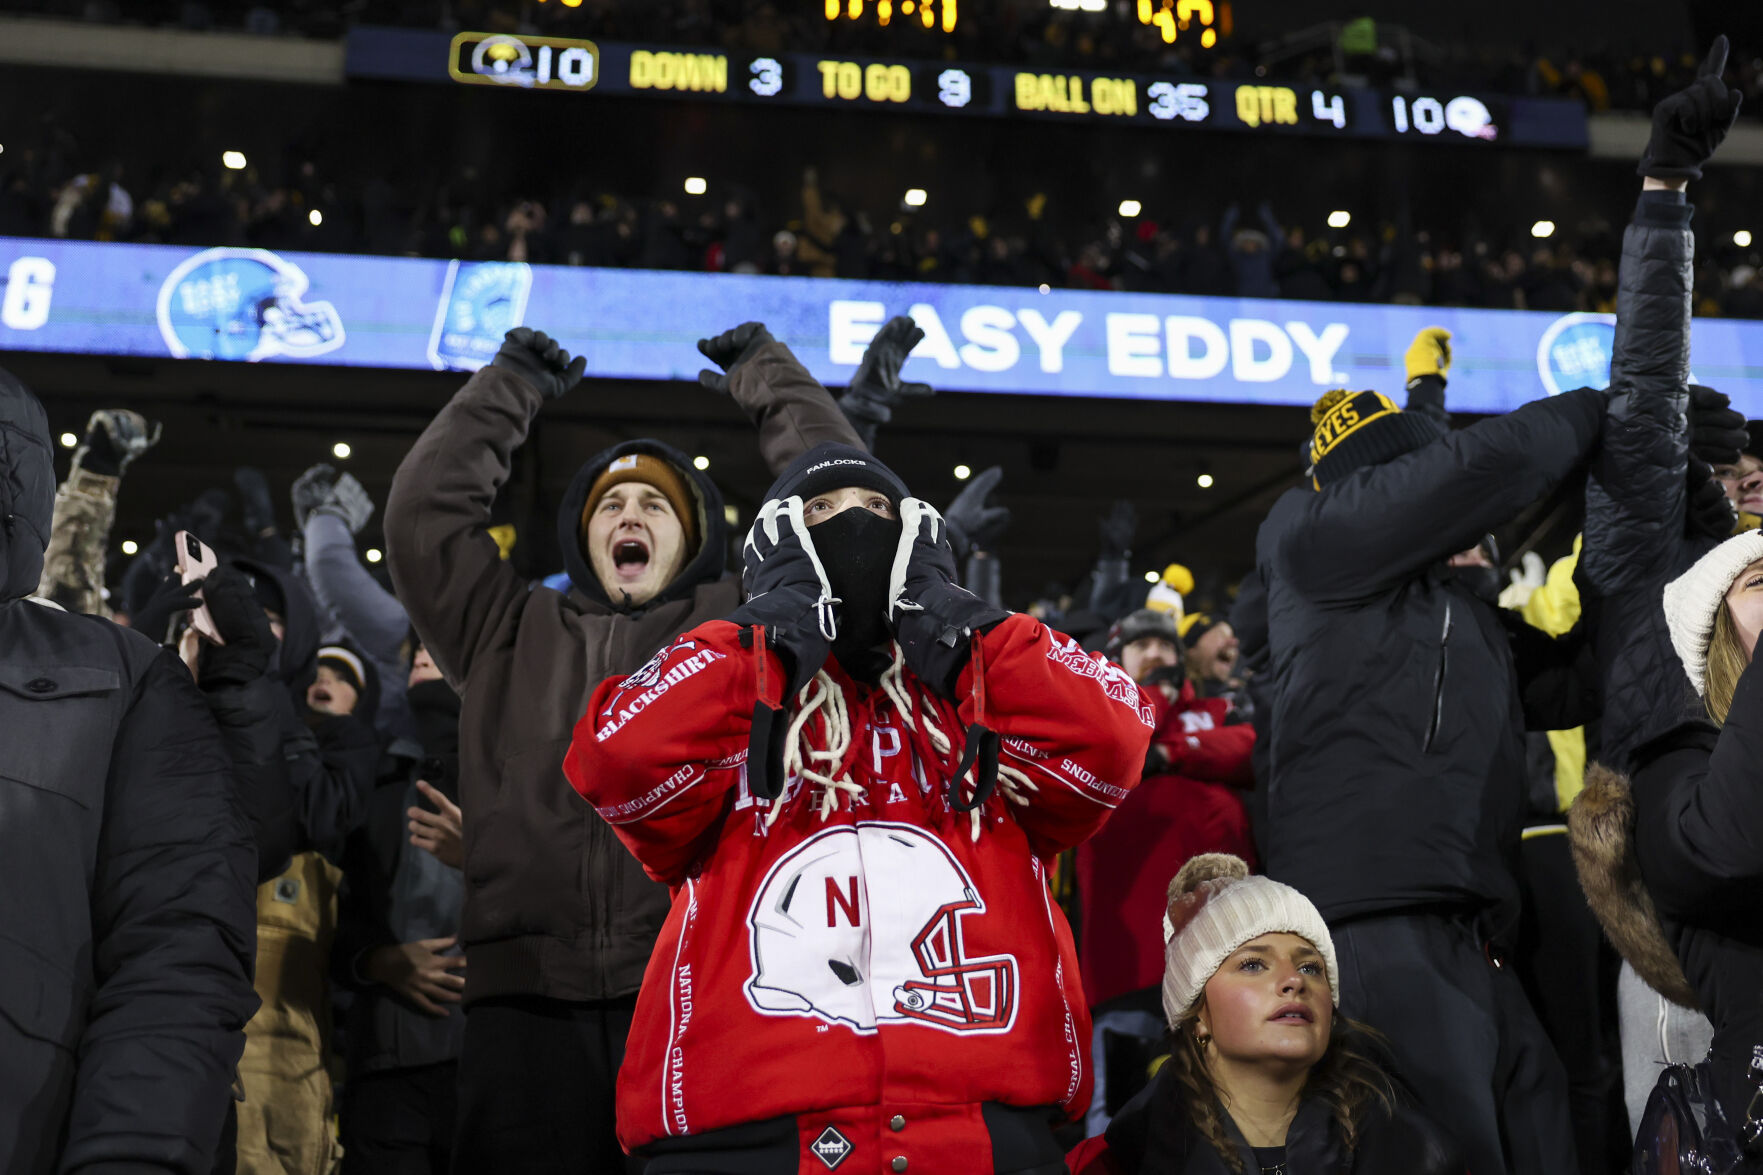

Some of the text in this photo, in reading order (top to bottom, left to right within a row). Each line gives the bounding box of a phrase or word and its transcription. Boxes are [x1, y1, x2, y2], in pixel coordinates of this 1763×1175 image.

[535, 44, 1445, 135] 10 DOWN 3 TO GO 9 BALL ON 35 QTR 4 10
[829, 301, 1350, 385] EASY EDDY
[806, 458, 867, 475] FANLOCKS
[1178, 710, 1216, 734] N
[824, 875, 861, 928] N
[675, 962, 693, 1044] NATIONA
